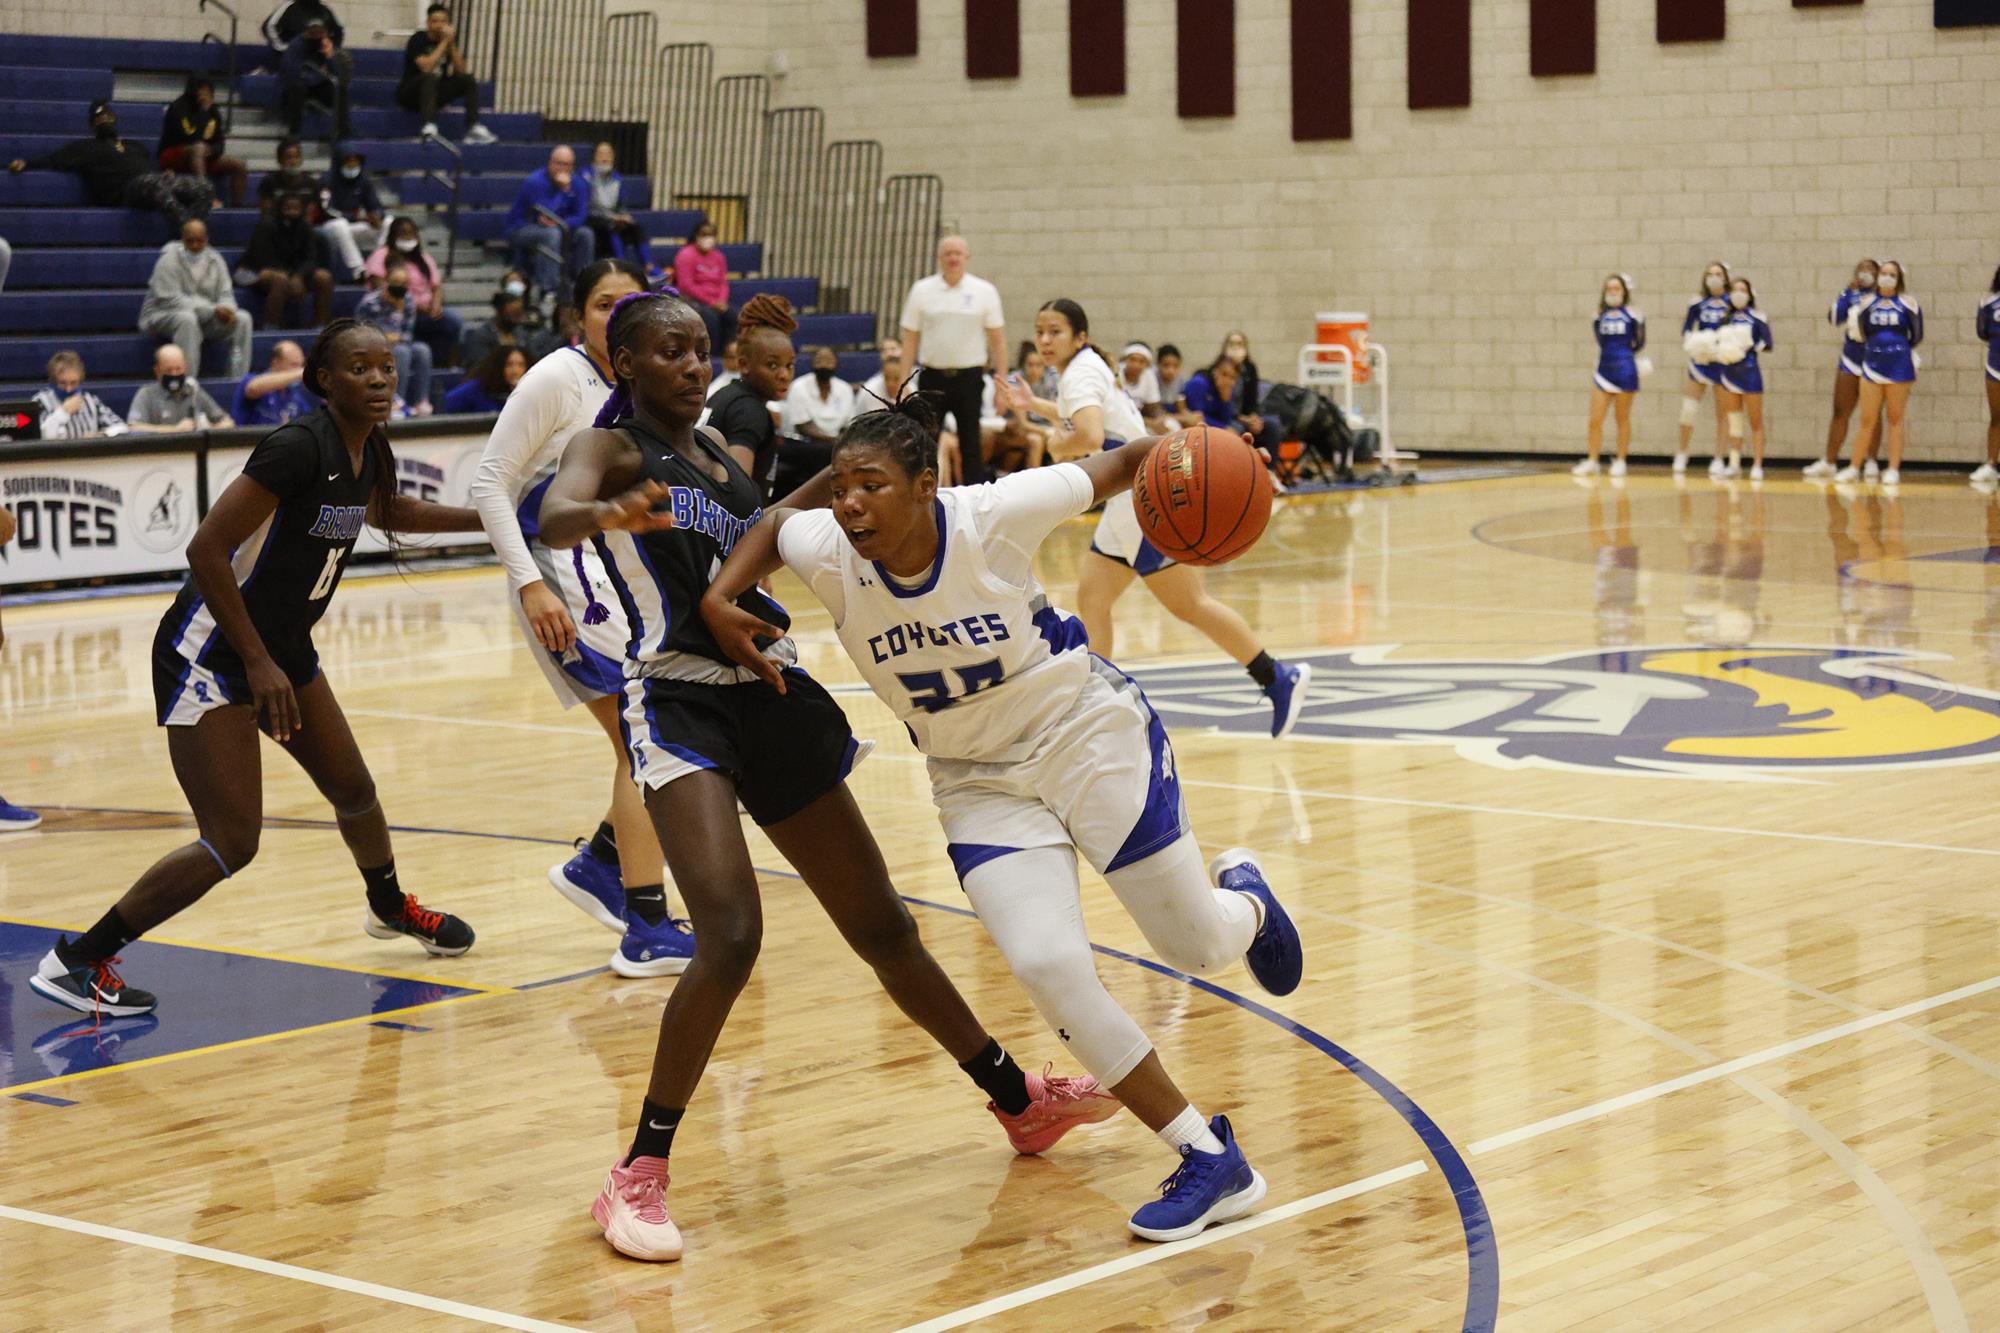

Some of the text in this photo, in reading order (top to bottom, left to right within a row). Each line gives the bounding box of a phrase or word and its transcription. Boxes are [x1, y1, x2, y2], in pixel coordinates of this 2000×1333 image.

[3, 477, 123, 506] SOUTHERN NEVADA
[3, 500, 118, 564] OTES
[867, 613, 1010, 665] COYOTES
